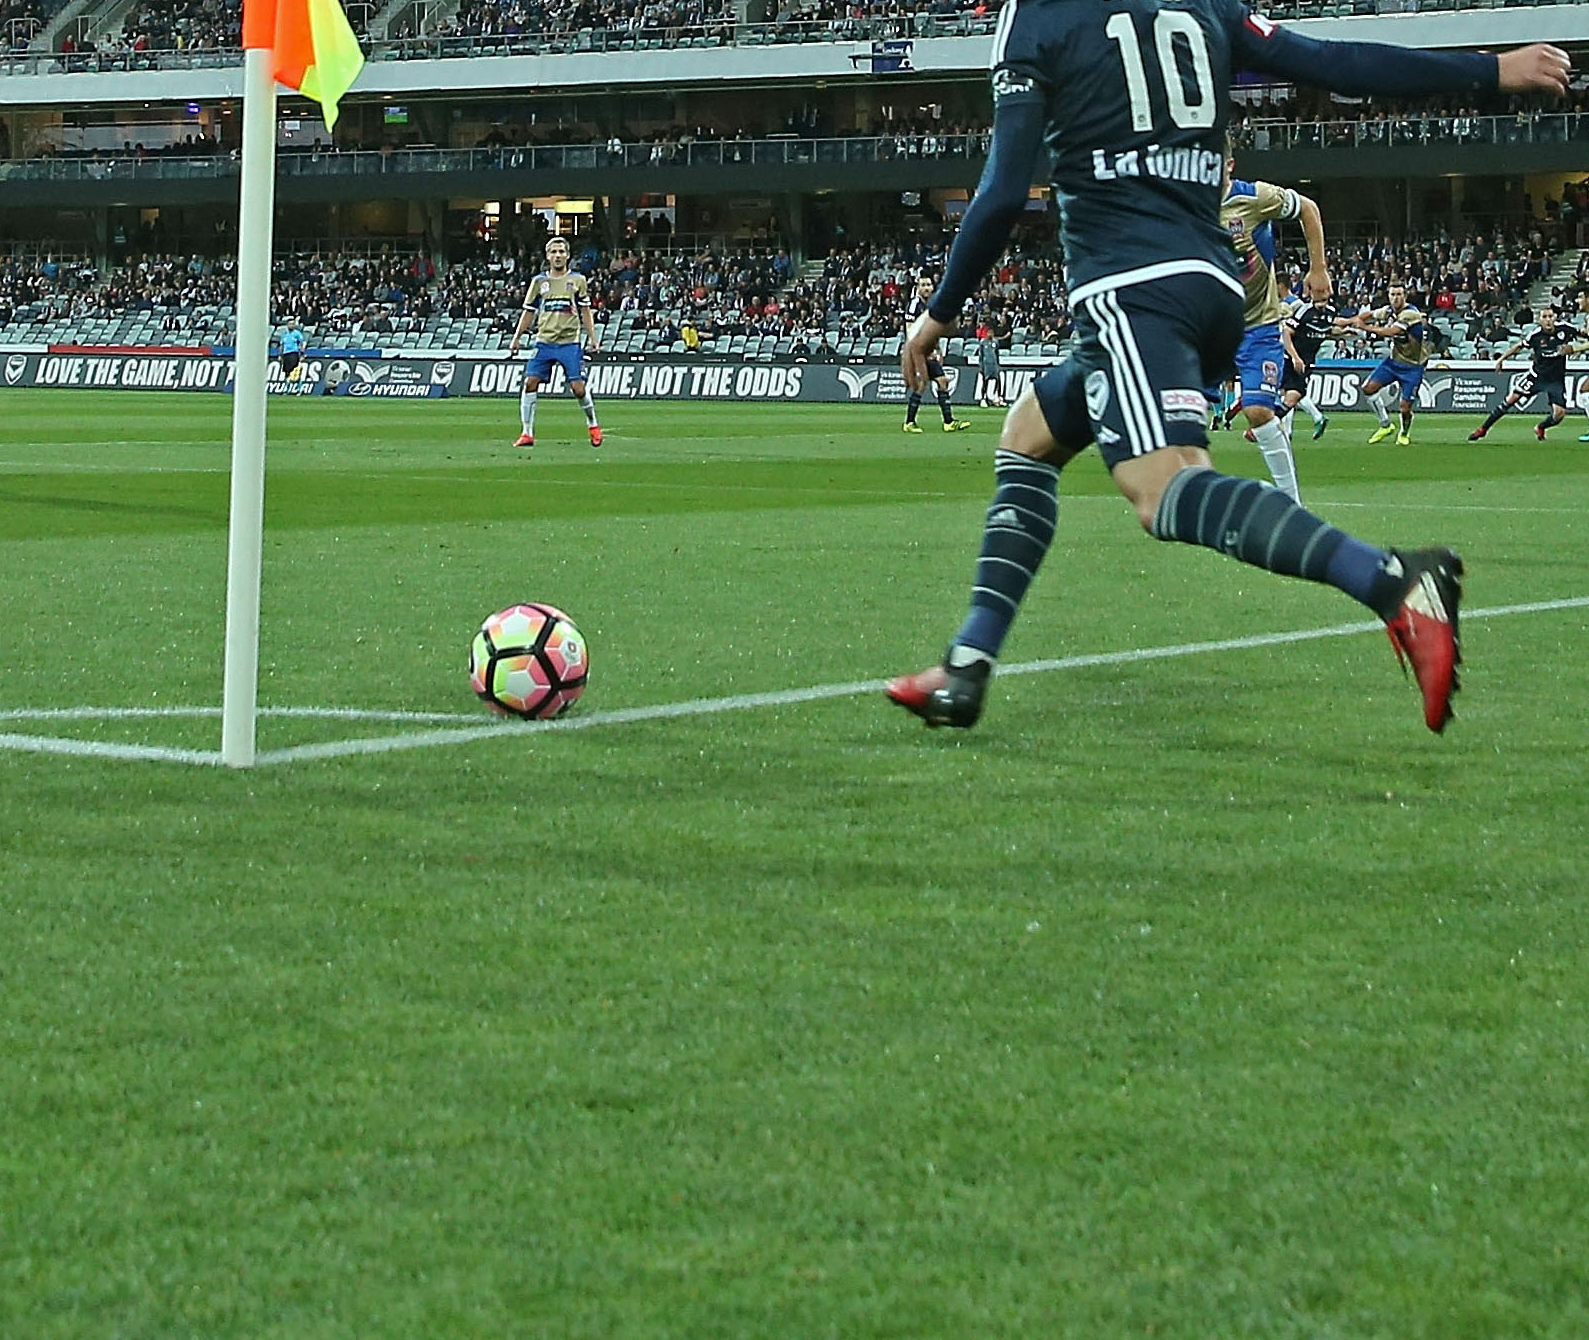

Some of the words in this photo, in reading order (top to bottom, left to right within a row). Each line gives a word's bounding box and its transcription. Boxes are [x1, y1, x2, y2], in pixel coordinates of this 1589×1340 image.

[1105, 9, 1217, 132] 10
[35, 356, 86, 384] LOVE
[83, 357, 124, 386] THE
[121, 358, 180, 389] GAME,
[179, 360, 226, 388] NOT
[586, 365, 637, 398] AME,
[636, 366, 691, 398] NOT
[690, 367, 737, 397] THE
[735, 367, 803, 397] ODDS
[372, 384, 431, 397] HYUNDAI
